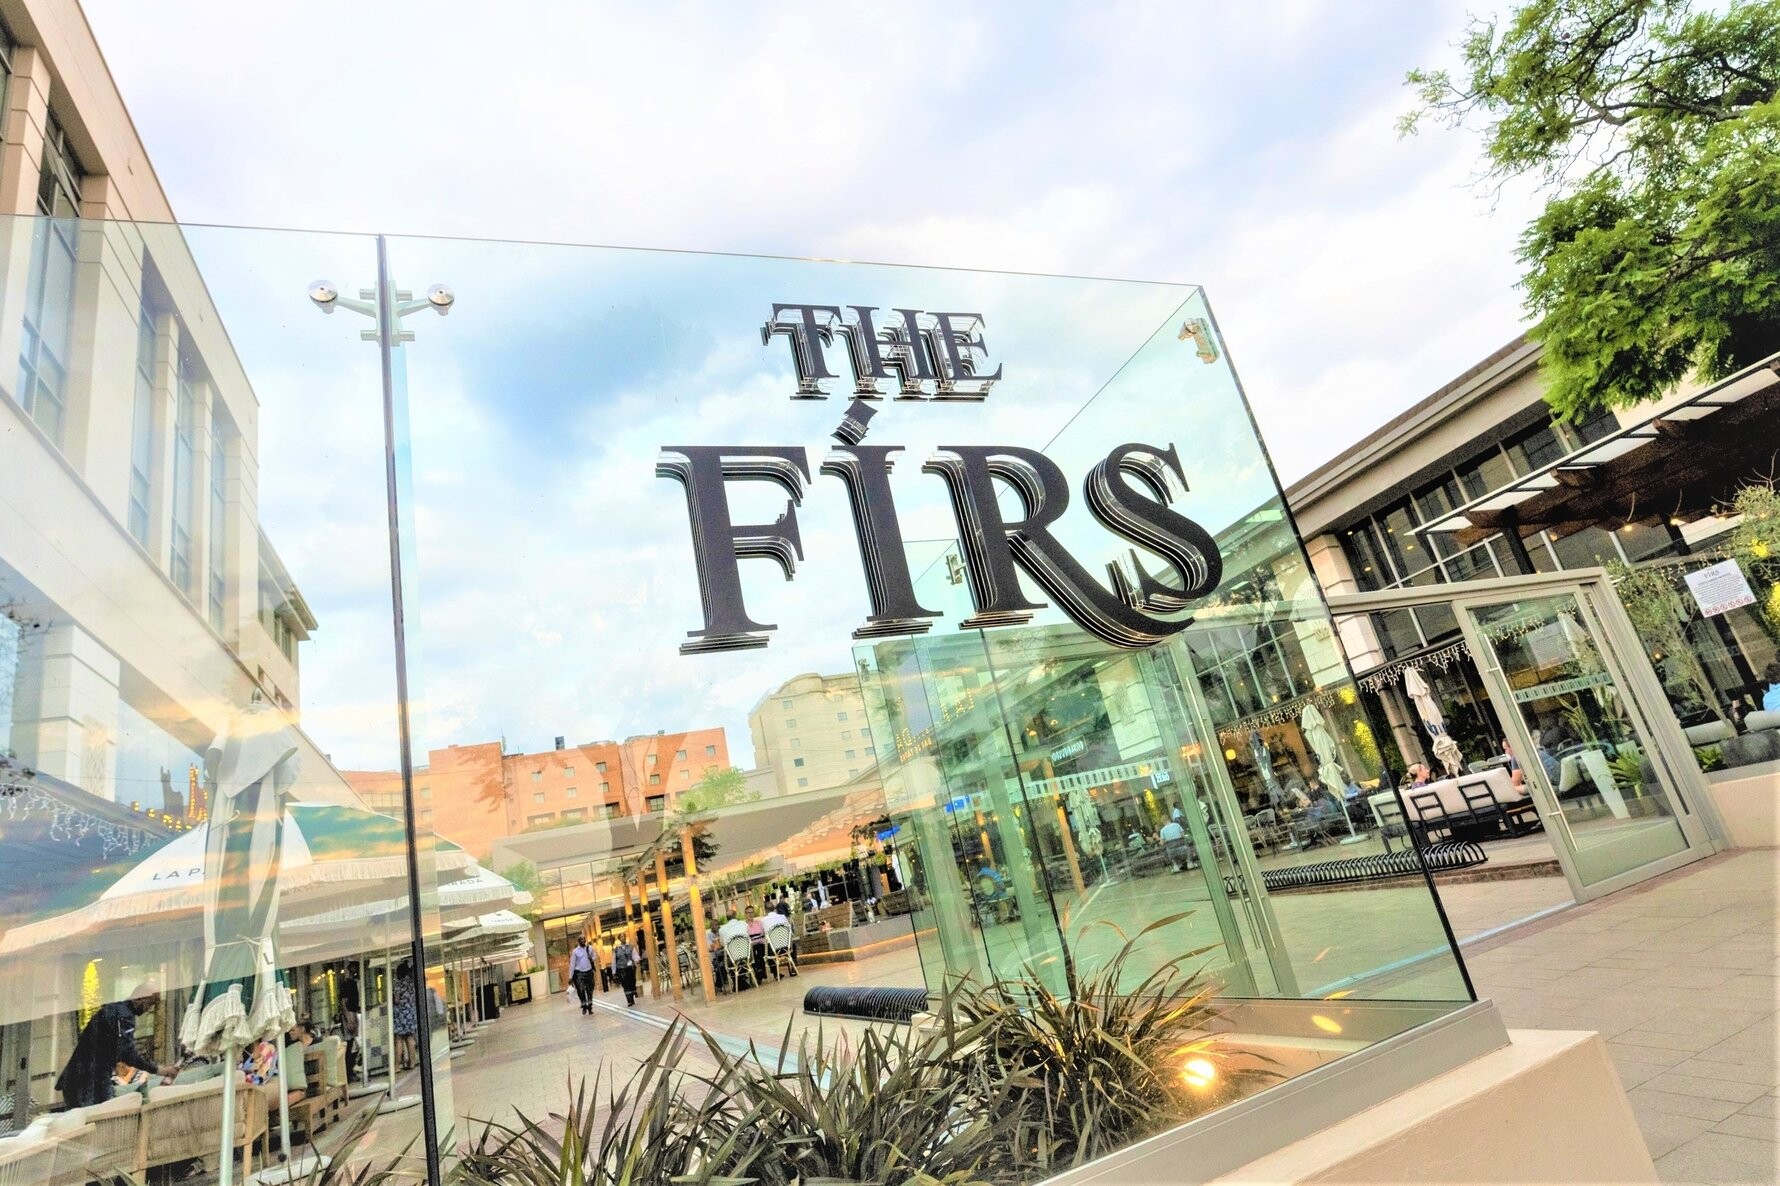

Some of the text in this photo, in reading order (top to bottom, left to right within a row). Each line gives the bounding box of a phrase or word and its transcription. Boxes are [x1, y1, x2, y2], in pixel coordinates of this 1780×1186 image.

[760, 302, 1003, 403] THE
[654, 401, 1224, 656] FIRS
[152, 869, 180, 881] LA
